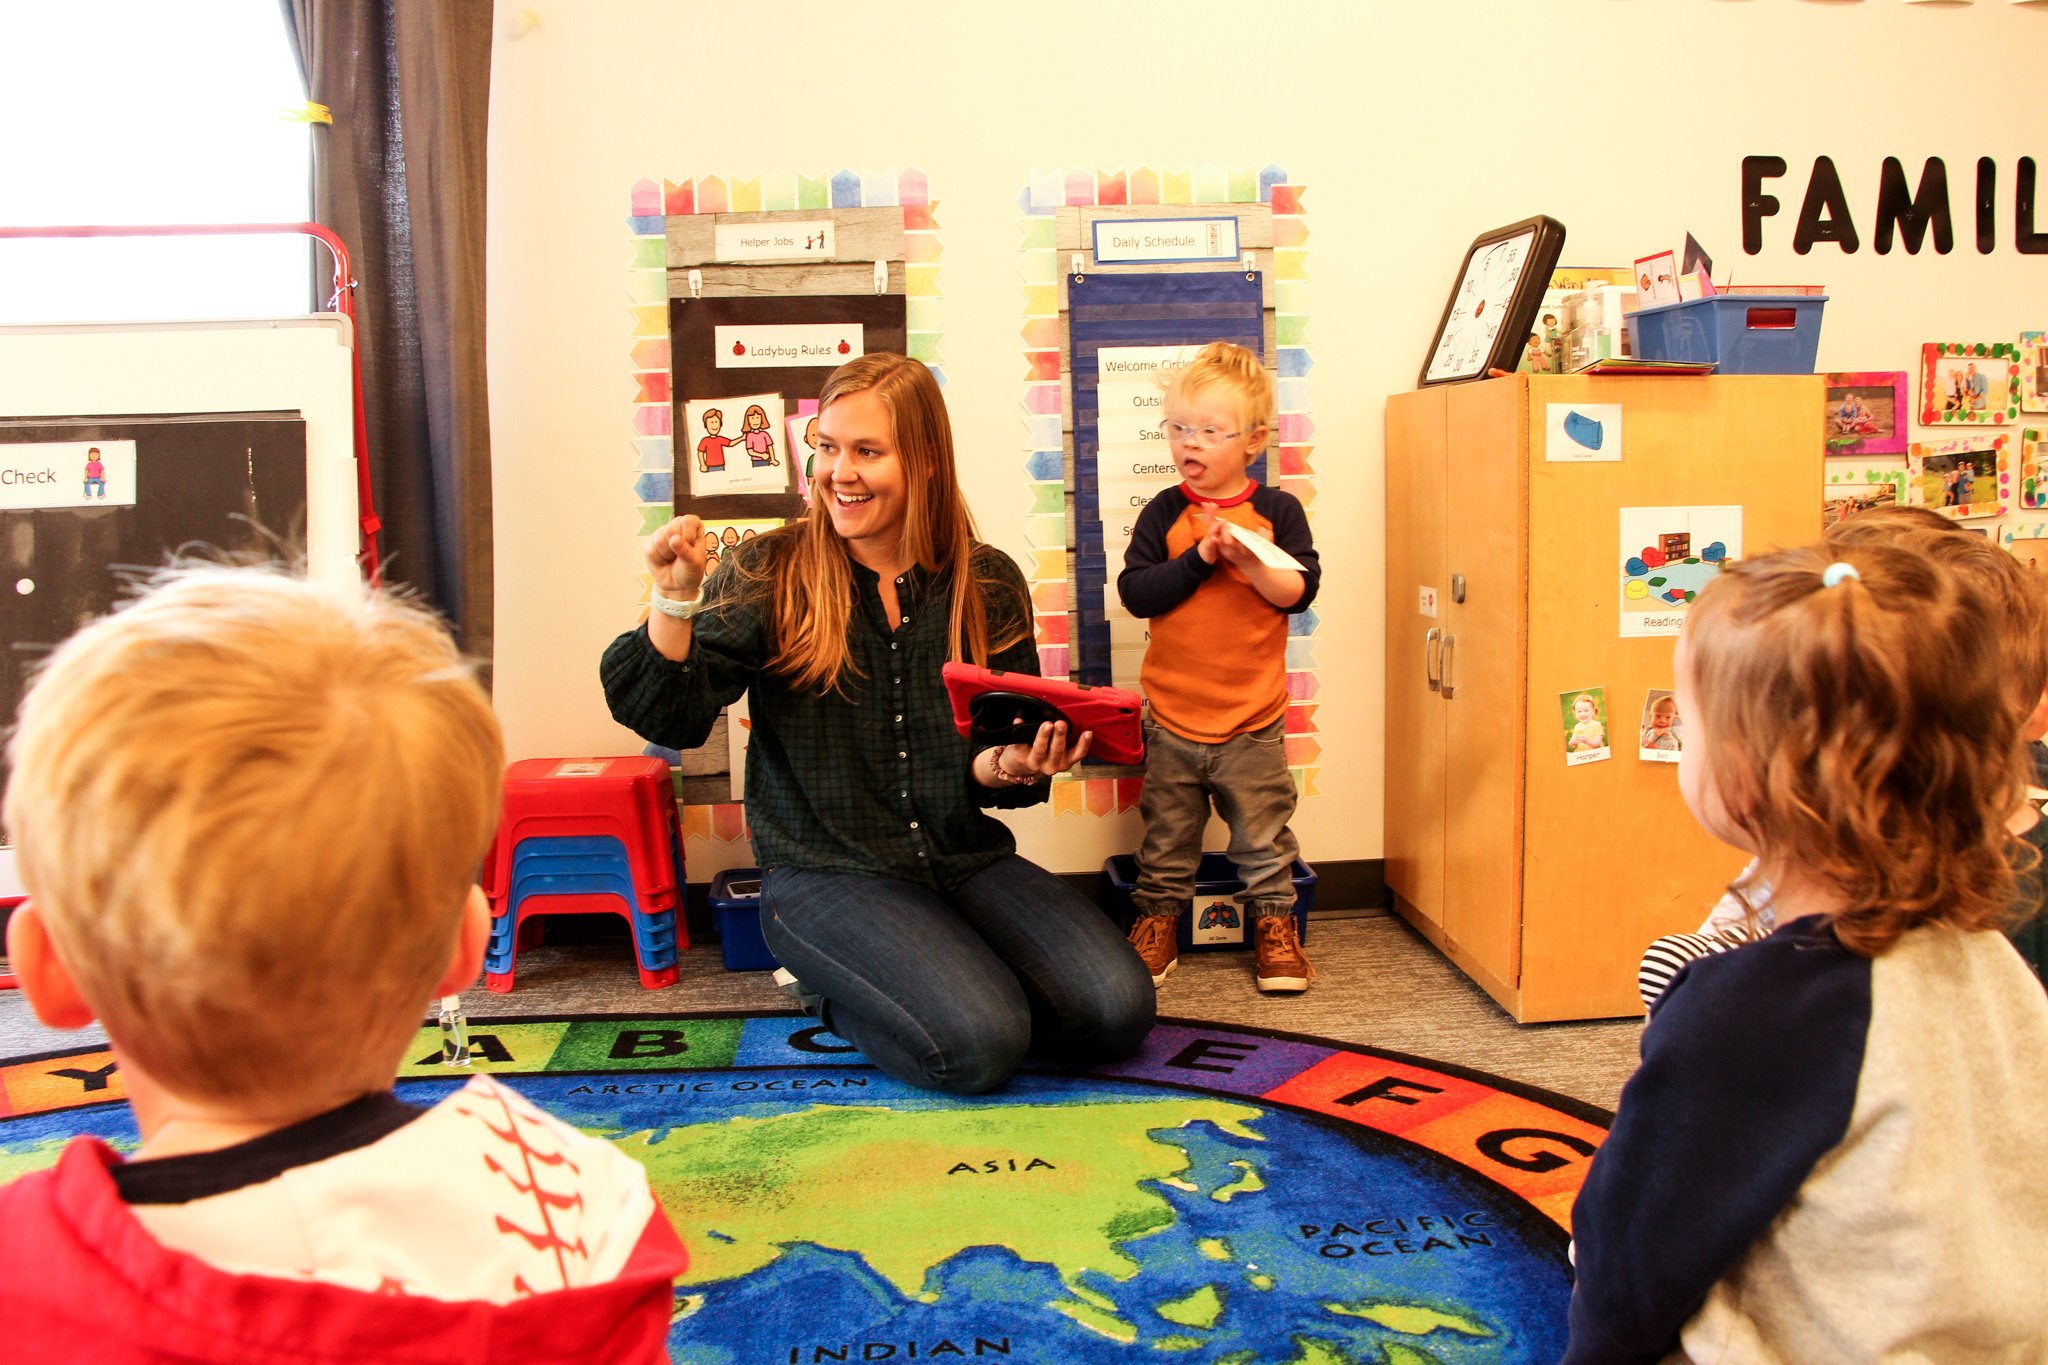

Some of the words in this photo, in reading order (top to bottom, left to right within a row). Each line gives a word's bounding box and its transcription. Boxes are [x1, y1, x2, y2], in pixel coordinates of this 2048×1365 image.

[1741, 155, 2048, 255] FAMIL
[740, 237, 770, 248] Helper
[773, 237, 794, 246] Jobs
[1113, 236, 1140, 250] Daily
[1144, 235, 1195, 247] Schedule
[751, 345, 797, 358] Ladybug
[801, 345, 831, 355] Rules
[1105, 361, 1157, 372] Welcome
[1133, 396, 1164, 407] Outsi
[1139, 429, 1168, 441] Snac
[1, 468, 57, 484] Check
[1132, 463, 1177, 474] Centers
[1130, 496, 1152, 507] Cle
[1644, 617, 1683, 629] Reading
[415, 1034, 515, 1066] A
[608, 1030, 689, 1059] B
[1165, 1039, 1260, 1073] E
[568, 1082, 714, 1096] ARCTIC
[731, 1077, 869, 1092] OCEAN
[1332, 1075, 1445, 1107] F
[1475, 1127, 1599, 1174] G
[947, 1158, 1056, 1175] ASIA
[1300, 1211, 1495, 1240] PACIFIC
[1319, 1232, 1493, 1259] OCEAN
[789, 1337, 1010, 1365] INDIAN
